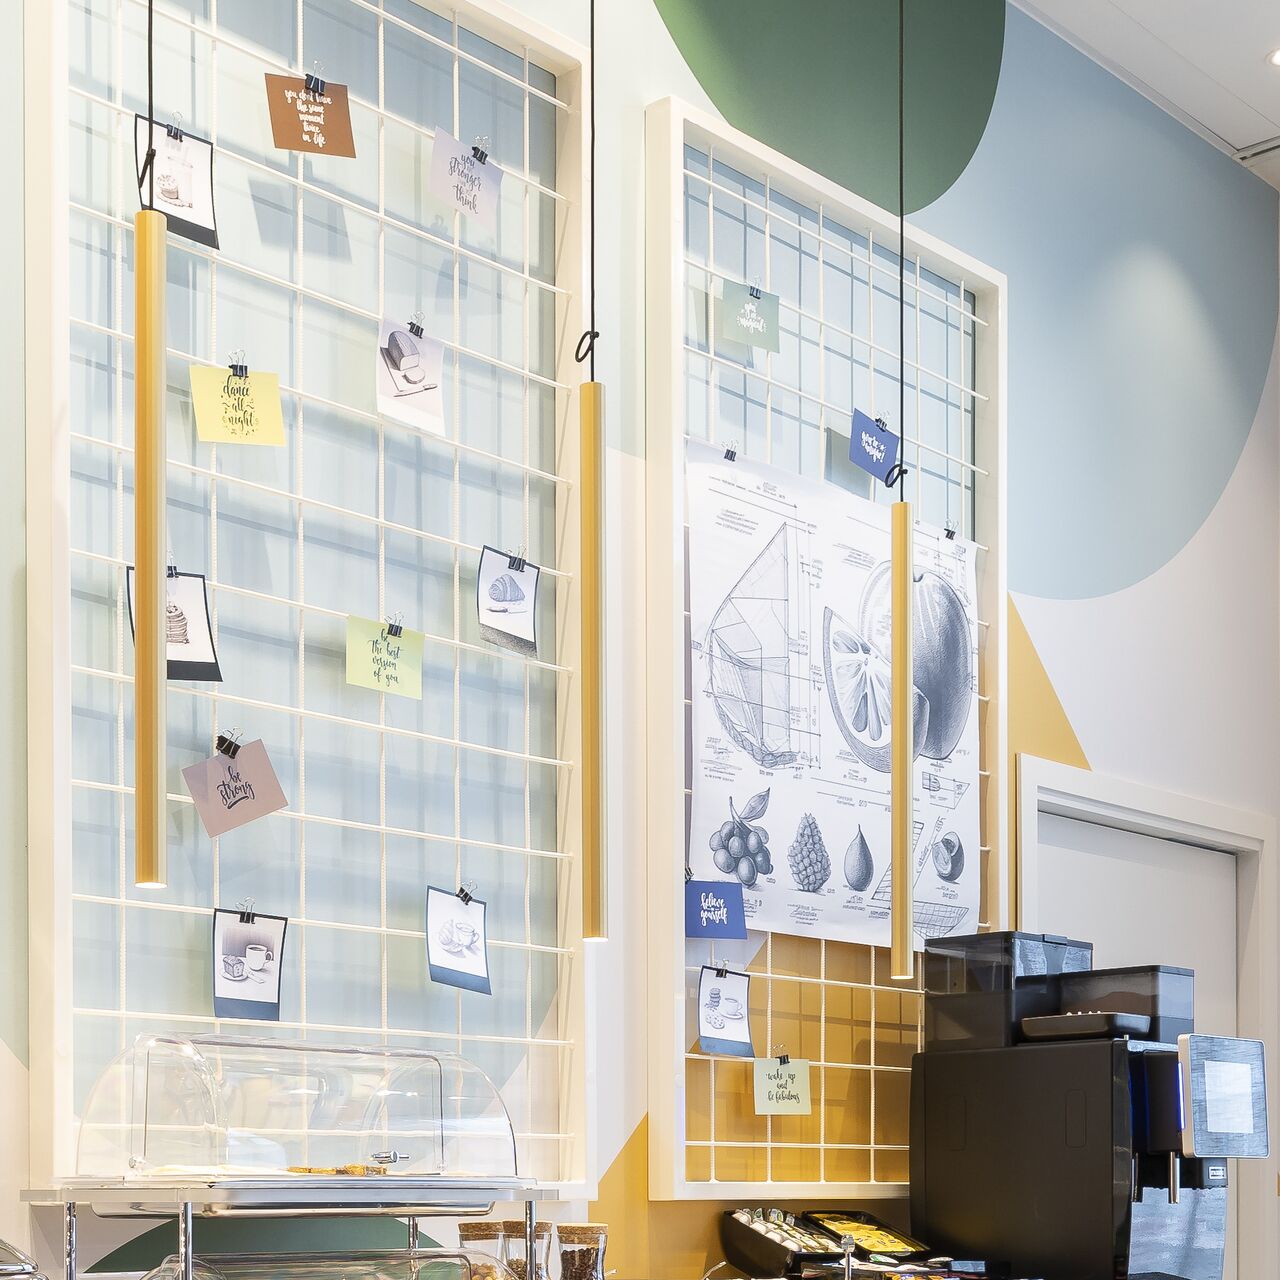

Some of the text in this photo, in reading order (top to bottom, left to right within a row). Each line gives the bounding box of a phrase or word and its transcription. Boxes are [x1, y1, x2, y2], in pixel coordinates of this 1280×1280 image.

[461, 154, 475, 170] you
[448, 157, 482, 191] stronger
[452, 184, 478, 214] think
[223, 374, 250, 398] dance
[231, 397, 244, 413] all
[228, 410, 253, 431] night
[373, 667, 382, 683] of
[227, 765, 242, 783] be
[216, 780, 255, 806] strong
